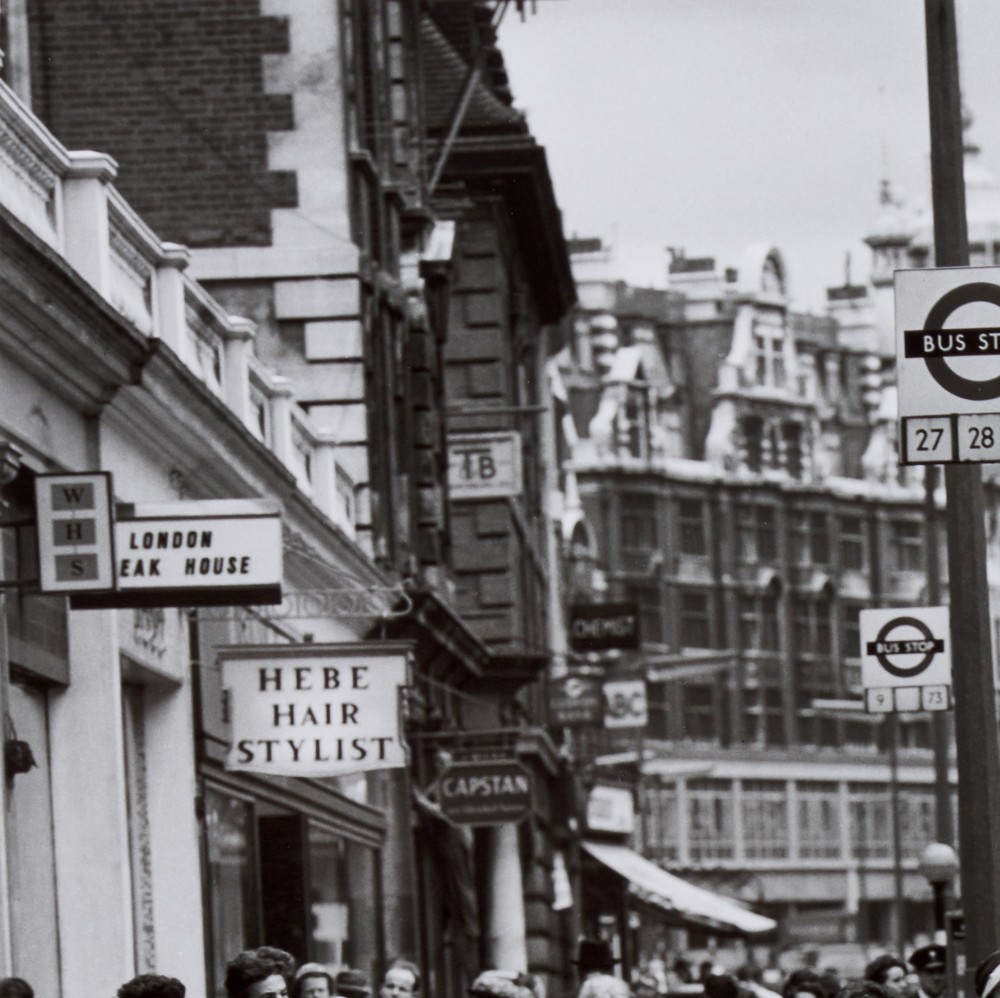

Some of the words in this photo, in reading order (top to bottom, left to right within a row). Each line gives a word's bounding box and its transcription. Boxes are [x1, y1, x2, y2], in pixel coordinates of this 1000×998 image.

[923, 334, 966, 353] BUS
[915, 428, 944, 451] 27
[968, 427, 995, 449] 28
[129, 530, 213, 550] LONDON
[119, 558, 161, 577] EAK
[185, 556, 251, 576] HOUSE
[876, 642, 900, 654] BUS
[904, 641, 935, 653] STOP
[258, 666, 370, 692] HEBE
[272, 703, 360, 727] HAIR
[237, 737, 394, 764] STYLIST
[442, 775, 529, 797] CAPSTAN
